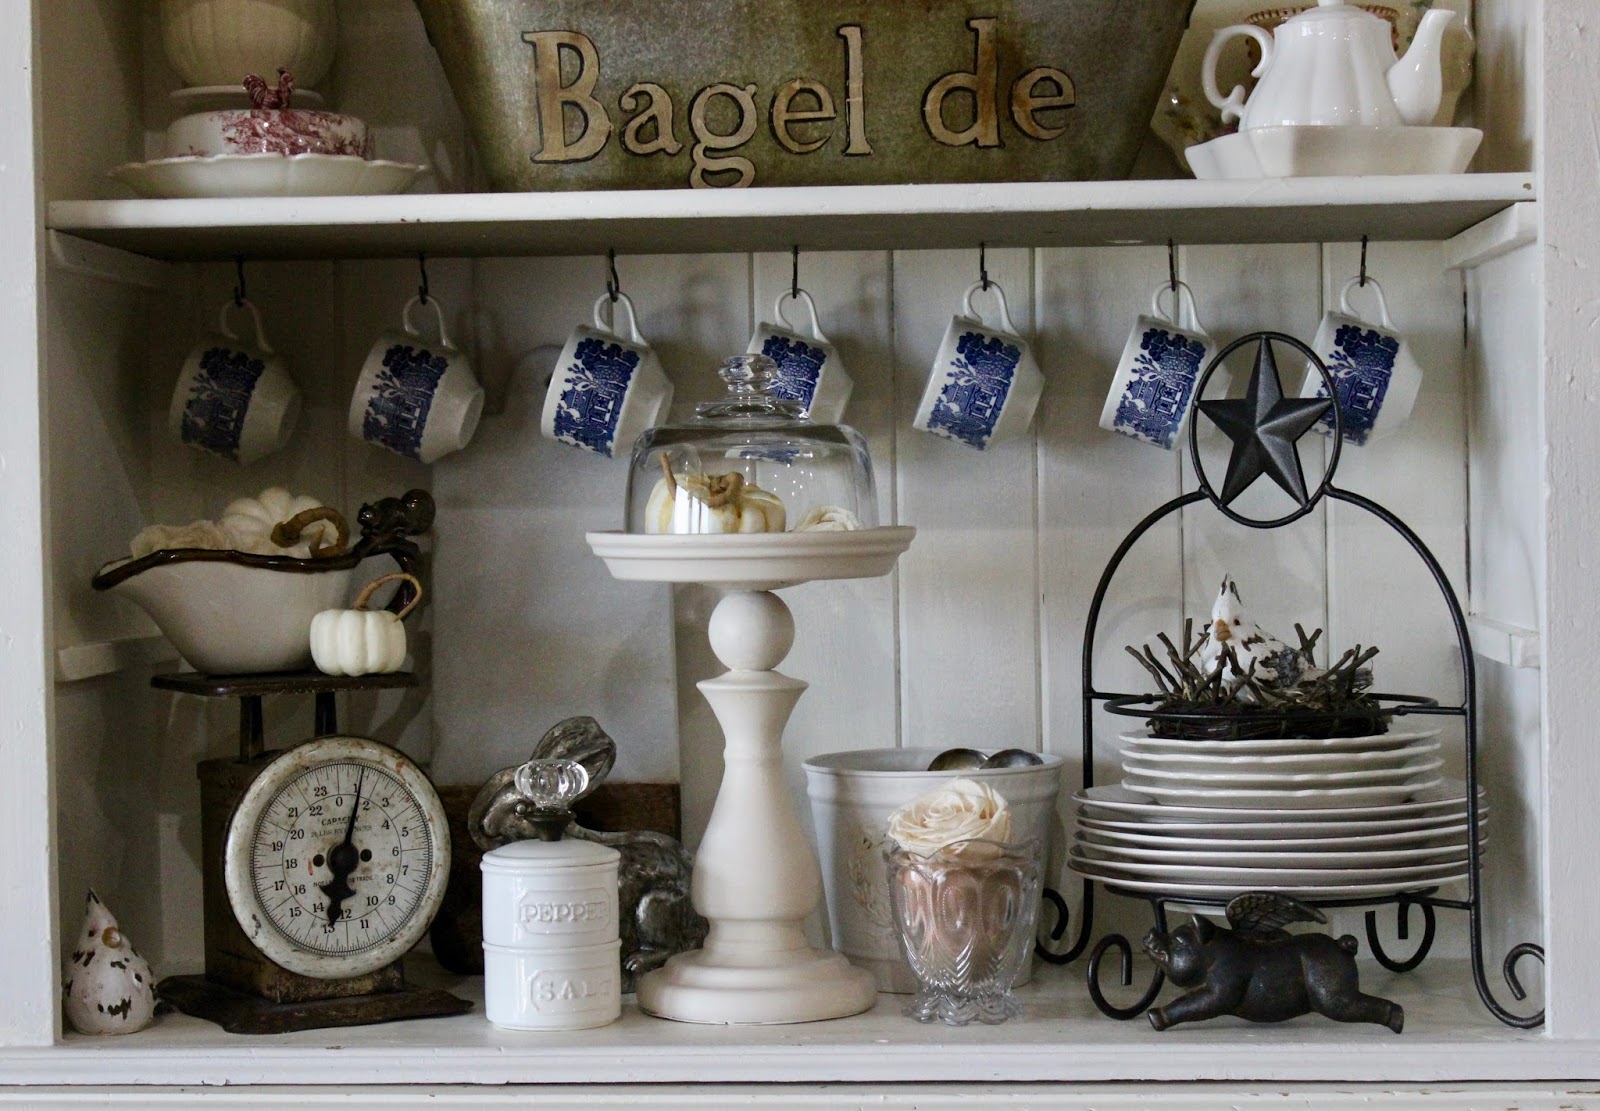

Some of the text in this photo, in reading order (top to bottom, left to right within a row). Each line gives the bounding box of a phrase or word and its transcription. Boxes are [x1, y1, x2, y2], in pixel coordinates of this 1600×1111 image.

[521, 16, 1076, 189] Bagel de
[313, 786, 327, 797] 23
[335, 797, 343, 807] 0
[363, 801, 370, 811] 2
[382, 798, 389, 807] 3
[288, 808, 299, 818] 21
[309, 807, 323, 817] 22
[381, 820, 390, 830] 4
[290, 829, 304, 840] 20
[402, 827, 409, 837] 5
[272, 841, 283, 851] 19
[392, 846, 399, 857] 6
[285, 859, 297, 869] 18
[402, 865, 409, 875] 7
[386, 874, 394, 884] 8
[274, 881, 285, 891] 17
[294, 885, 306, 895] 16
[366, 895, 379, 906] 10
[388, 895, 396, 906] 9
[289, 907, 302, 917] 15
[313, 902, 325, 913] 14
[340, 908, 352, 920] 12
[360, 919, 369, 929] 11
